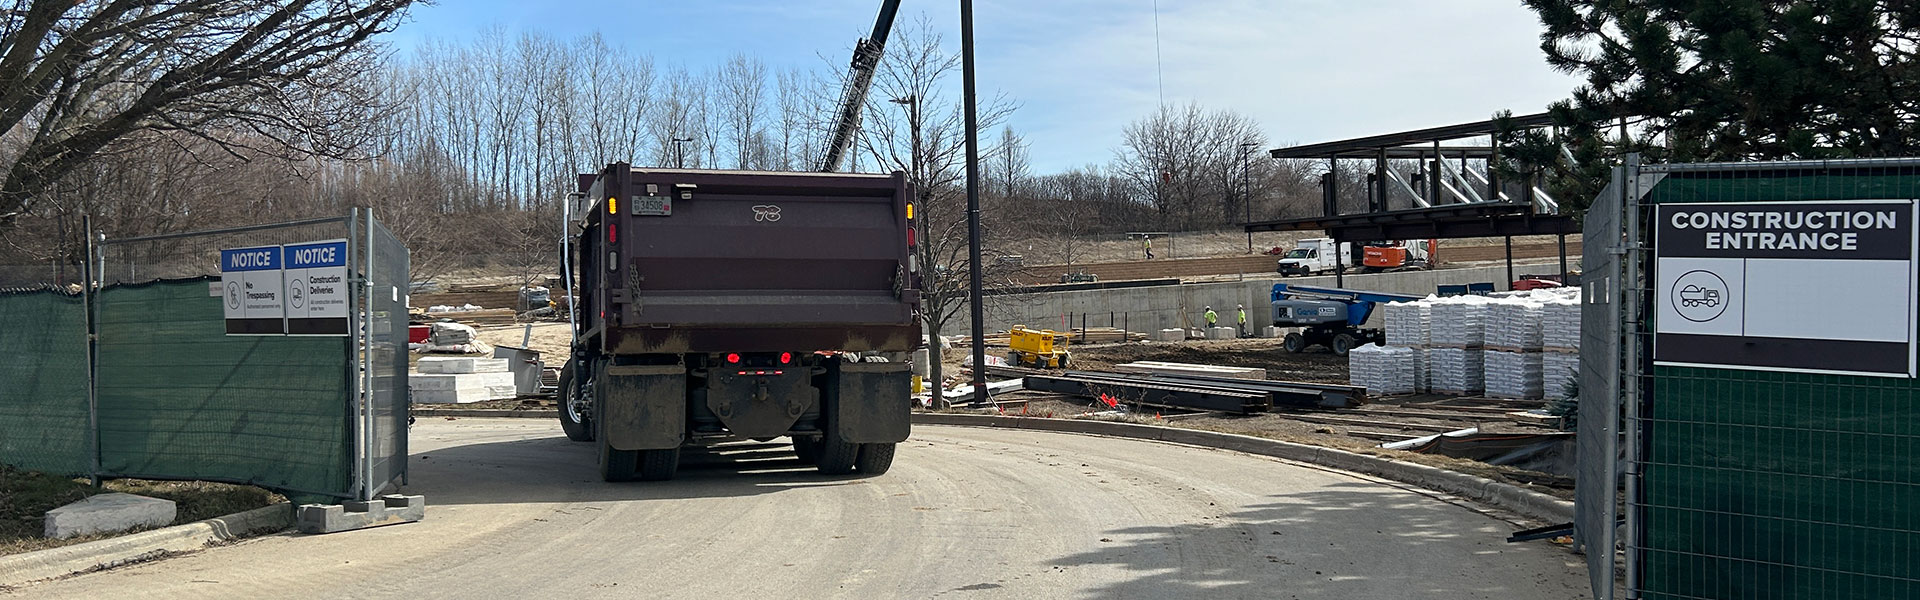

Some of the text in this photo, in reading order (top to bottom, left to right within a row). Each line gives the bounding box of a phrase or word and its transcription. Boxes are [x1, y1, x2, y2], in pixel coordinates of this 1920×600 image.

[1671, 211, 1897, 229] CONSTRUCTION
[1706, 232, 1857, 250] ENTRANCE
[231, 251, 271, 268] NOTICE
[294, 247, 336, 265] NOTICE
[310, 275, 341, 284] Construction
[245, 281, 254, 289] No
[310, 286, 334, 294] Deliveries
[246, 291, 275, 301] Trespassing
[1296, 307, 1318, 316] Genie
